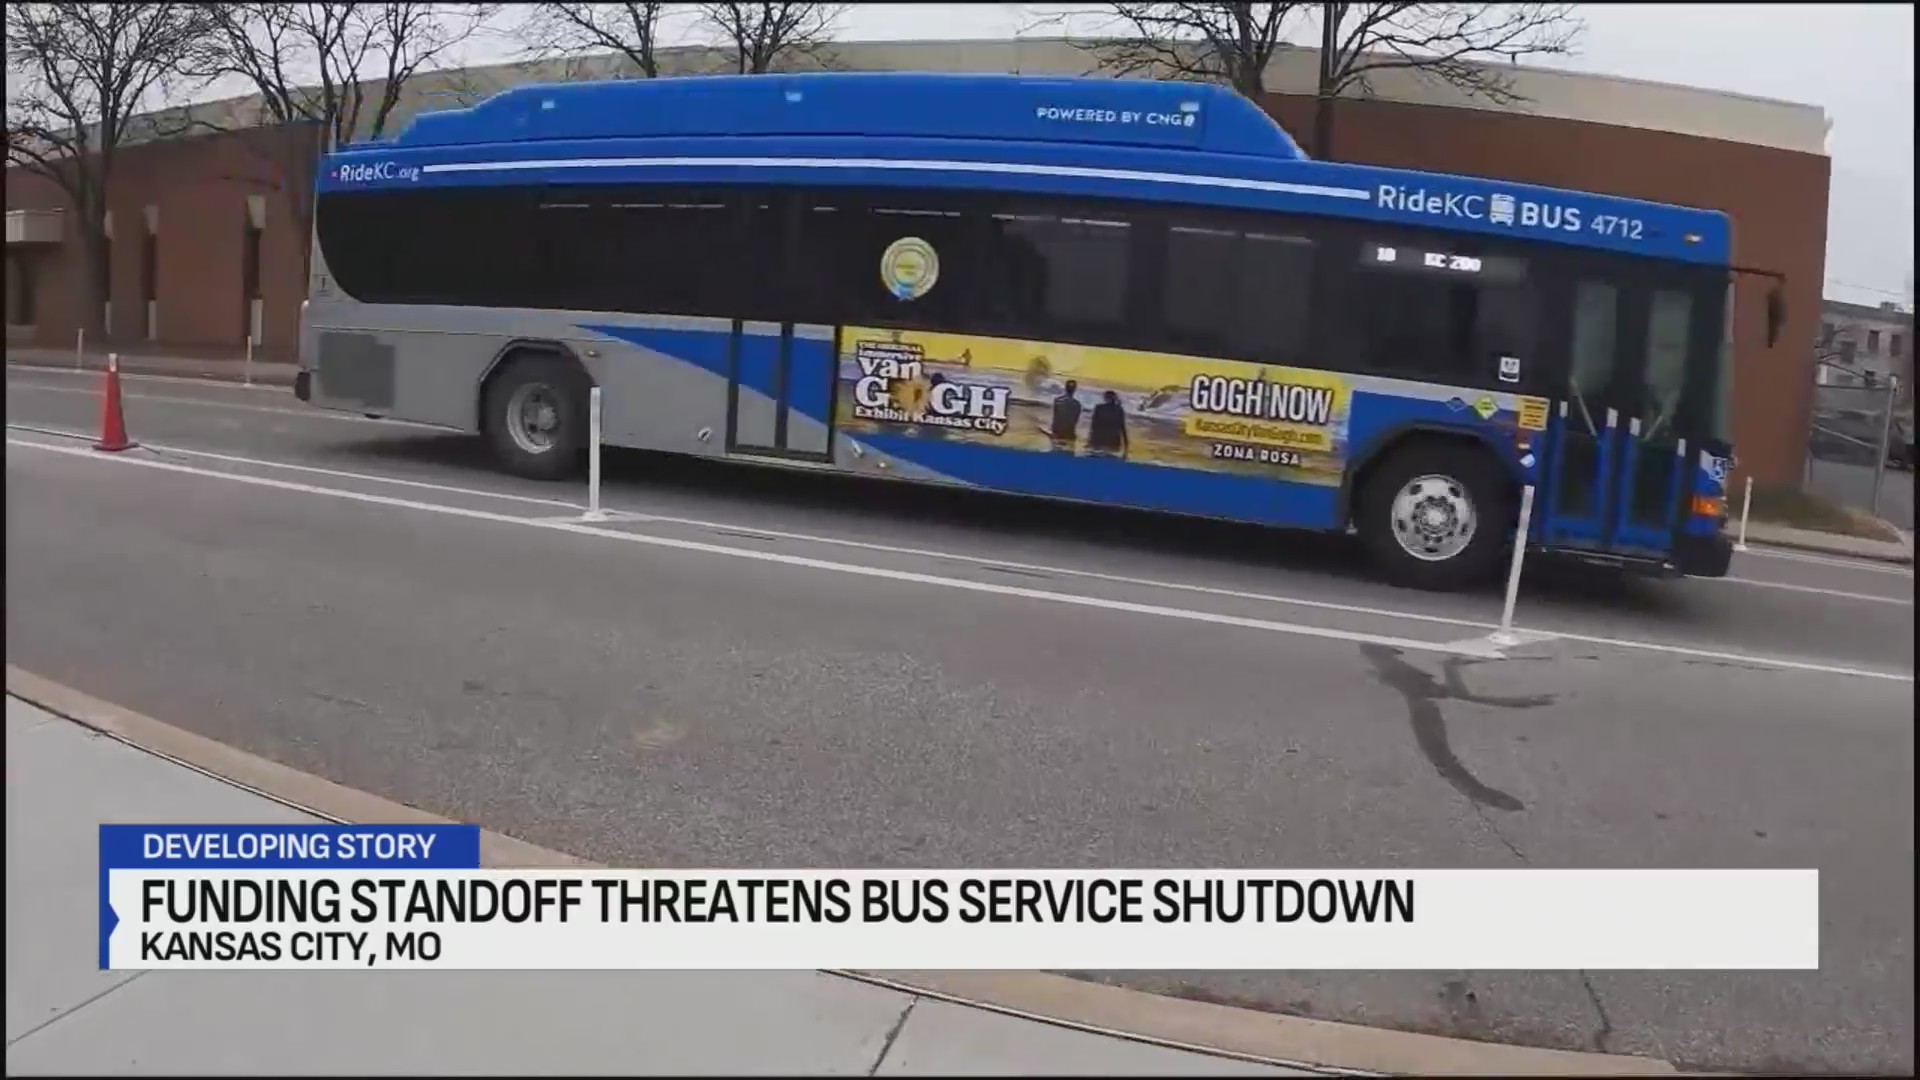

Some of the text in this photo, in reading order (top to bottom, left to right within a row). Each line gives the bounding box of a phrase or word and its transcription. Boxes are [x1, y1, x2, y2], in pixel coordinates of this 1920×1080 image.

[1036, 107, 1182, 126] POWERED BY CNG
[1377, 184, 1643, 240] RideKC BUS 4712
[1191, 375, 1333, 424] GOGH NOW
[855, 406, 1008, 435] Exhibit Kansas City
[1260, 449, 1299, 464] ROSA
